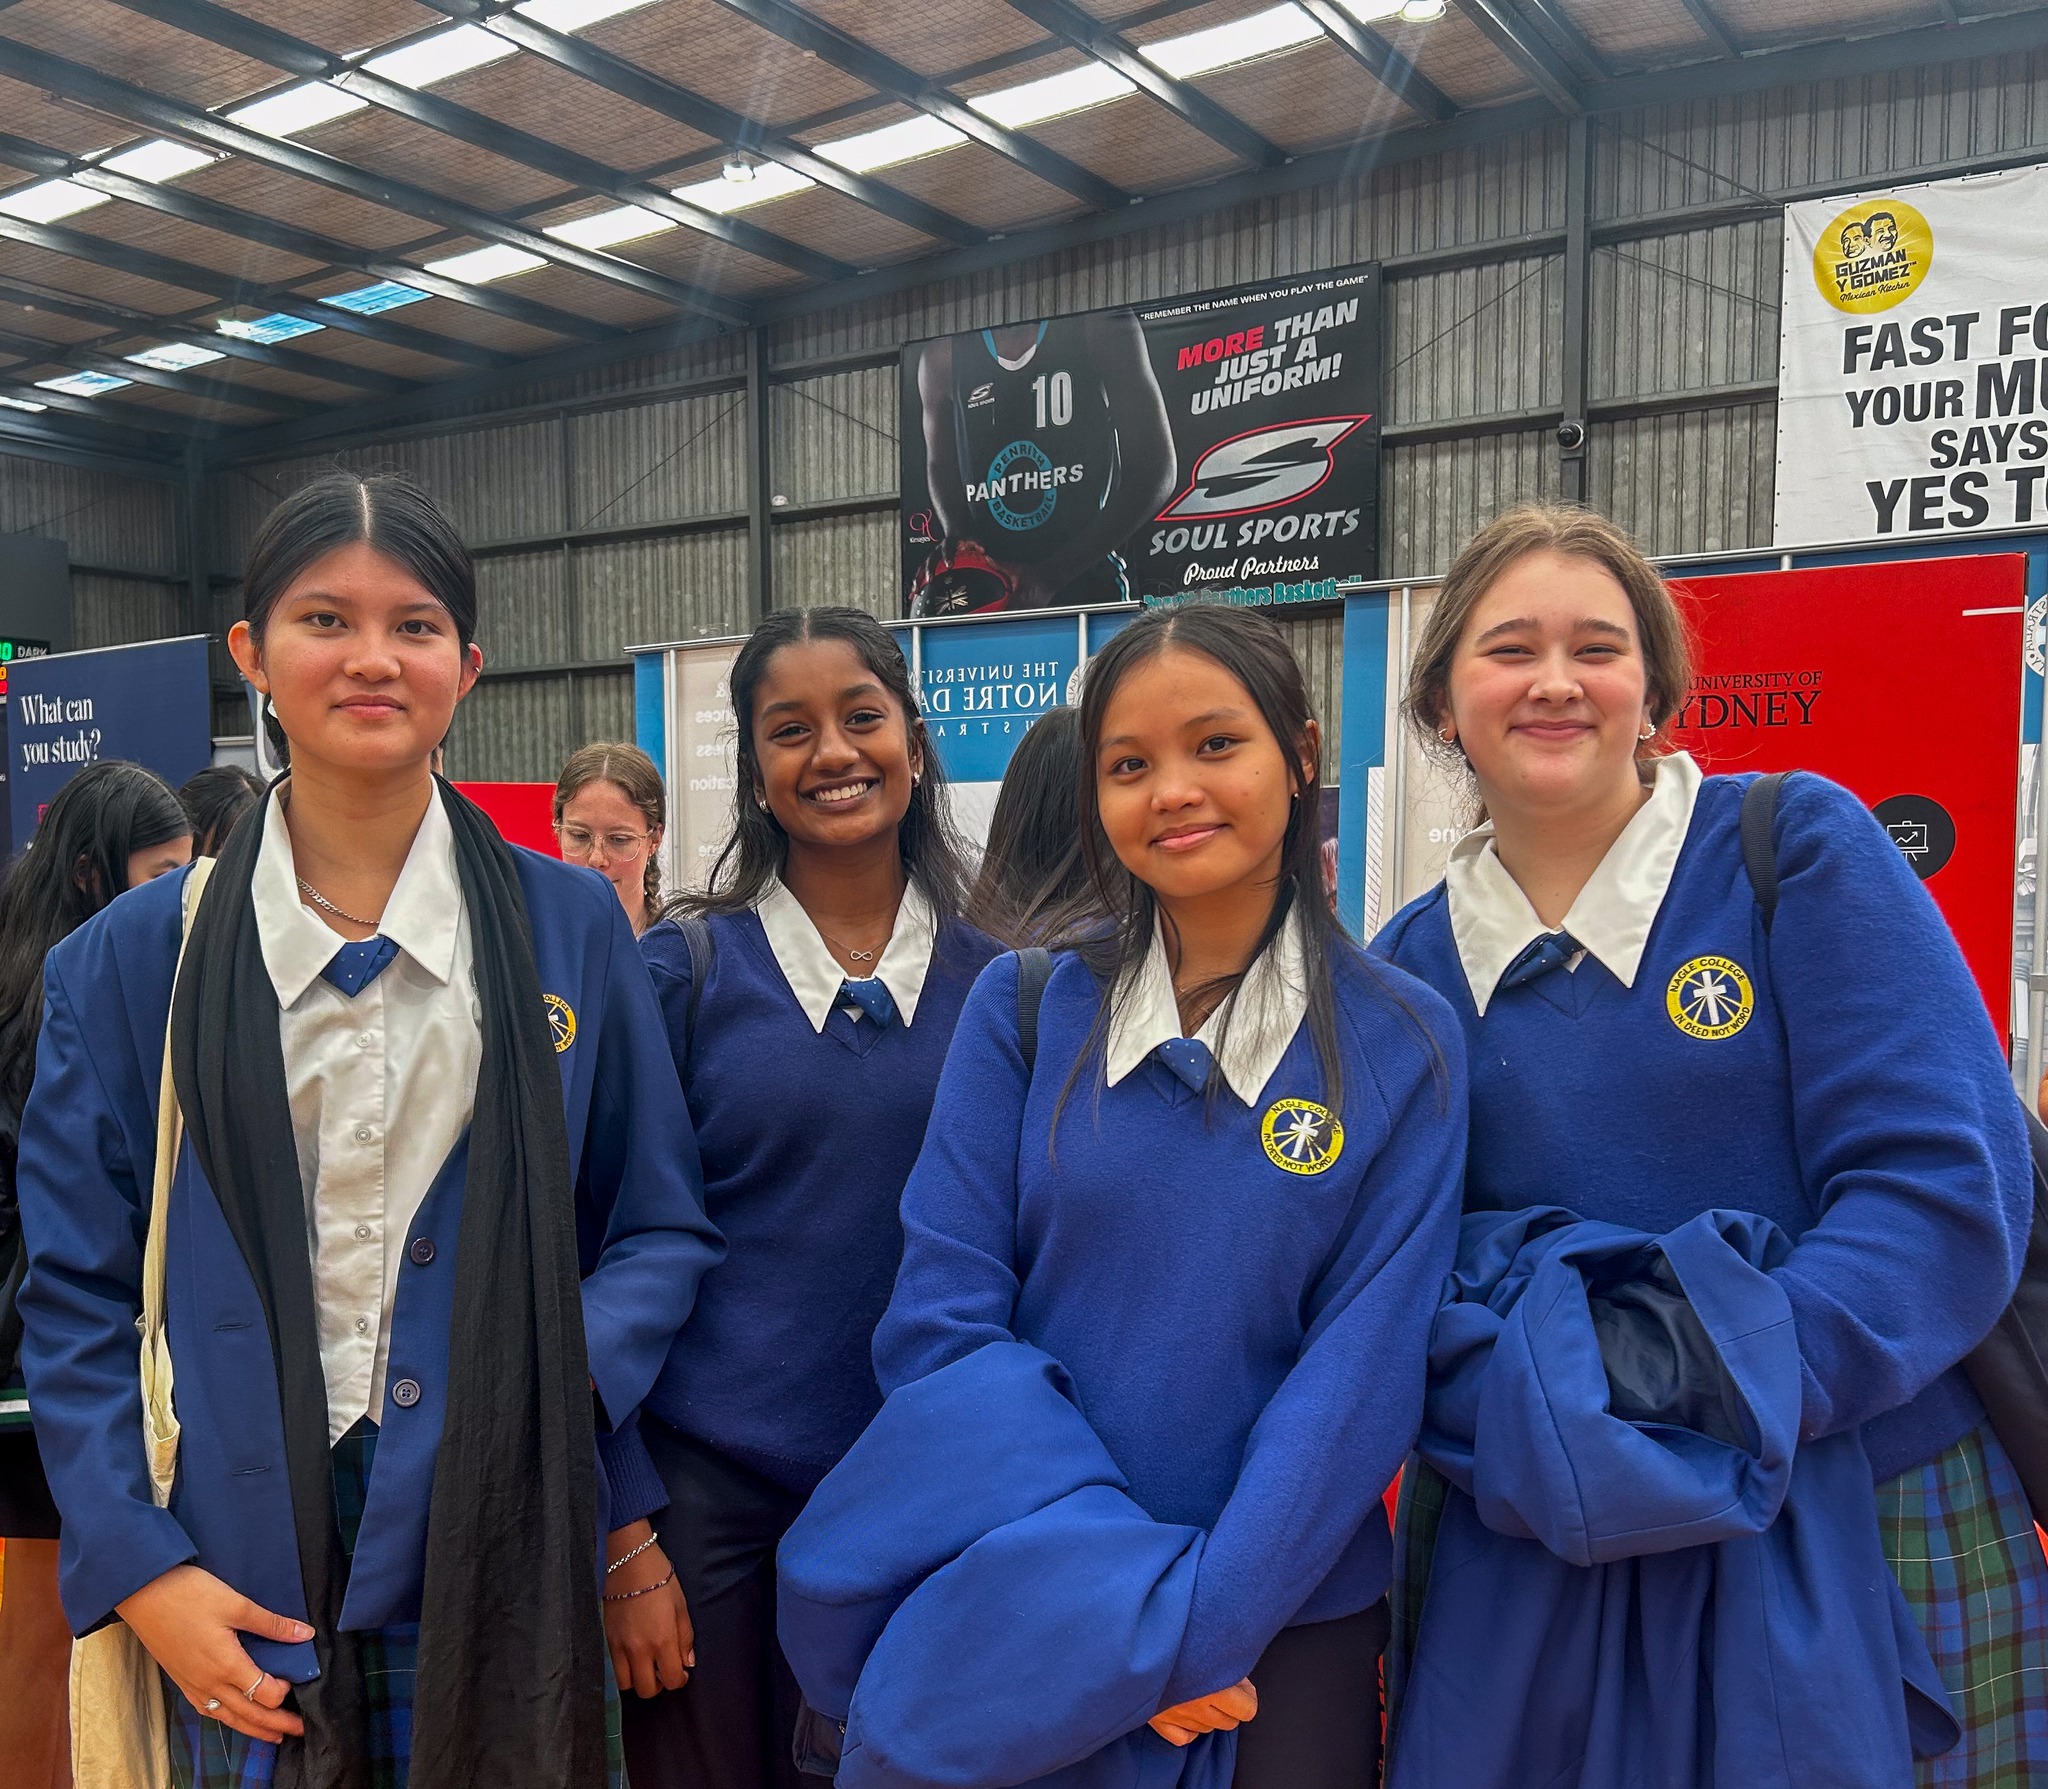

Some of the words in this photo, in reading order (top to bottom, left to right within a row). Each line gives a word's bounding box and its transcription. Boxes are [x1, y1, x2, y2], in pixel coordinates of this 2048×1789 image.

[1835, 249, 1907, 278] GUZMAN
[1836, 279, 1847, 292] Y
[1850, 263, 1910, 290] GOMEZ
[1193, 302, 1211, 312] THE
[1212, 297, 1239, 310] NAME
[1240, 292, 1268, 305] WHEN
[1269, 288, 1289, 299] YOU
[1290, 284, 1314, 296] PLAY
[1315, 280, 1334, 291] THE
[1839, 290, 1877, 302] Mexican
[1877, 281, 1911, 294] Kitchen
[1177, 325, 1265, 371] MORE
[1274, 298, 1359, 343] THAN
[1842, 311, 1980, 375] FAST
[1214, 343, 1287, 385] JUST
[1294, 335, 1318, 363] A
[1032, 371, 1073, 429] 10
[1190, 352, 1343, 416] UNIFORM!
[1845, 379, 1965, 428] YOUR
[1975, 357, 2048, 420] M
[994, 444, 1046, 474] PENRITH
[1930, 420, 2048, 470] SAYS
[966, 463, 1084, 502] PANTHERS
[991, 494, 1055, 528] BASKETBALL
[1865, 471, 1990, 534] YES
[1150, 523, 1229, 556] SOUL
[1236, 507, 1361, 547] SPORTS
[1183, 558, 1238, 585] Proud
[1240, 555, 1320, 581] Partners
[1688, 671, 1795, 691] UNIVERSITY
[1798, 670, 1823, 686] OF
[19, 693, 63, 726] What
[66, 698, 93, 723] can
[21, 742, 49, 773] you
[51, 727, 102, 768] study?
[1669, 962, 1697, 993] NAGLE
[1699, 958, 1746, 982] COLLEGE
[1673, 1013, 1686, 1025] IN
[1683, 1022, 1709, 1037] DEED
[1711, 1026, 1731, 1037] NOT
[1730, 1006, 1751, 1030] WORD
[1271, 1100, 1303, 1114] NAGLE
[1263, 1133, 1272, 1143] IN
[1266, 1143, 1283, 1163] DEED
[1282, 1160, 1303, 1172] NOT
[1305, 1155, 1332, 1173] WORD
